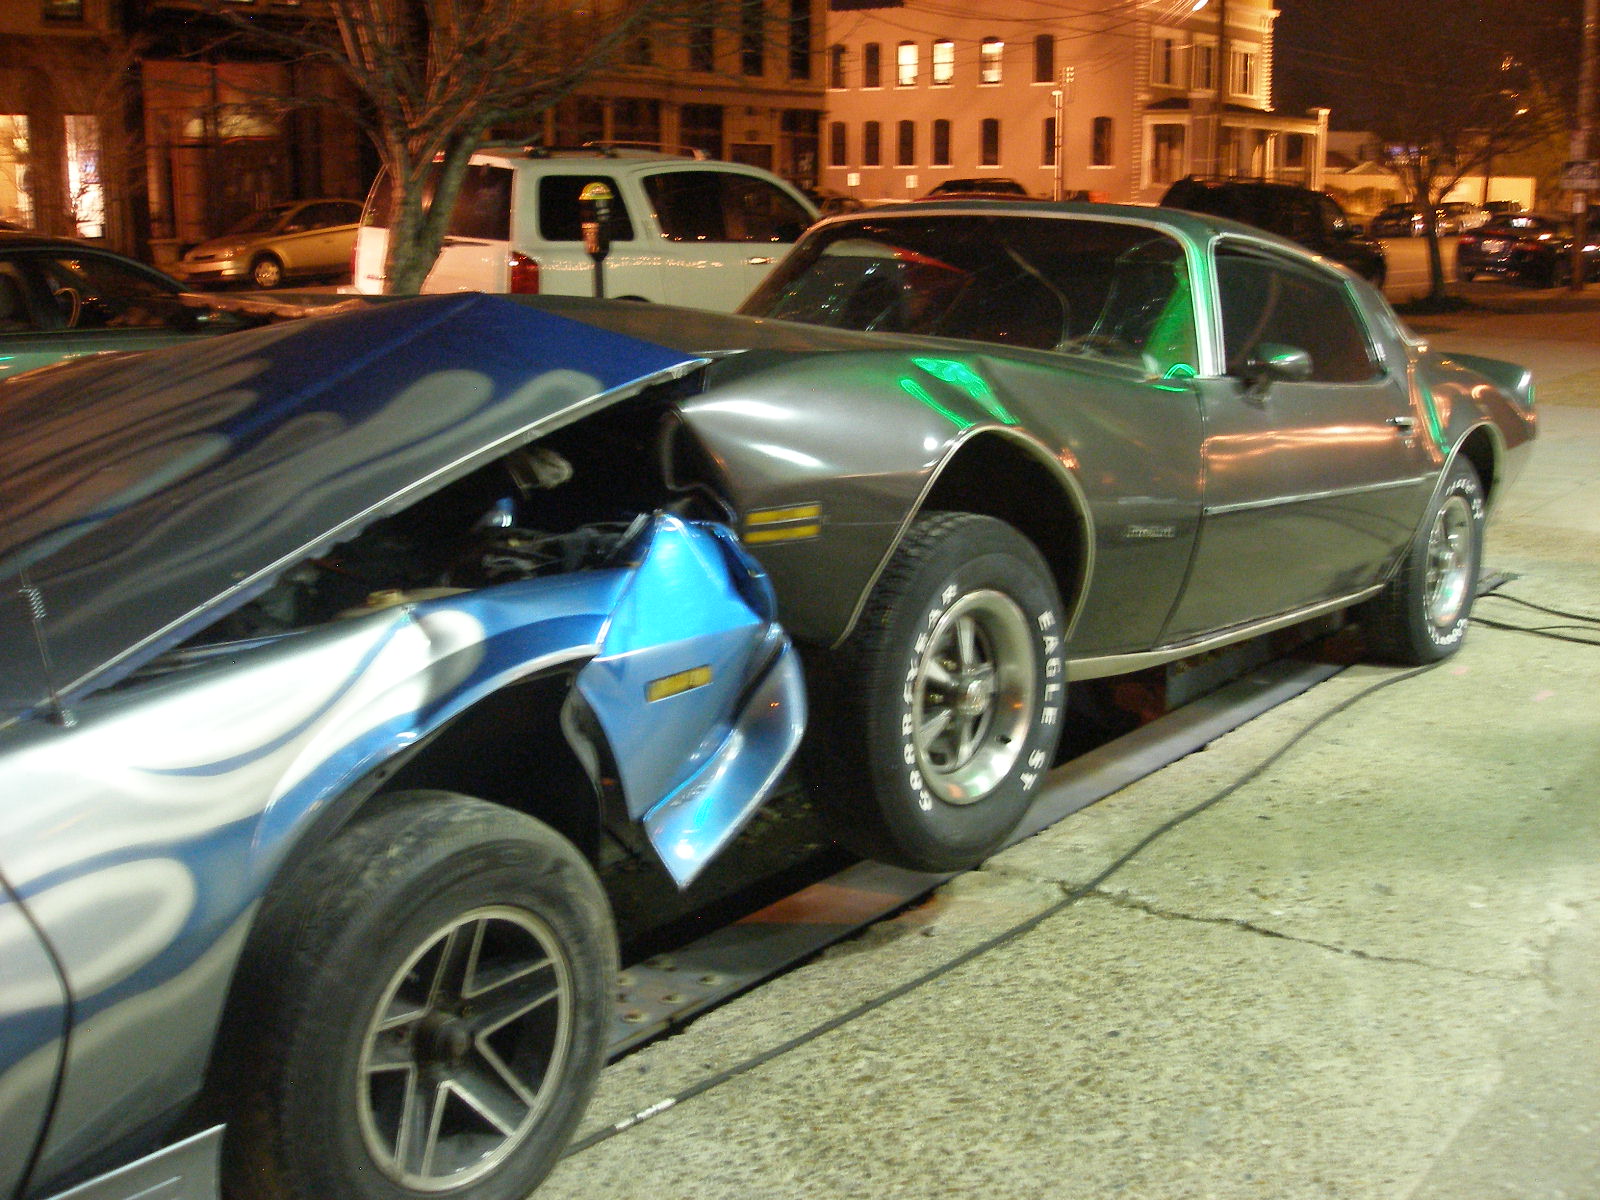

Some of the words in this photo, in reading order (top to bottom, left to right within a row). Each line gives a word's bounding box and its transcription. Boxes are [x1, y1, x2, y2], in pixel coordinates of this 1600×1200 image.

[902, 584, 958, 811] GOODYEAR
[1038, 609, 1061, 726] EAGLE
[1020, 749, 1046, 791] ST
